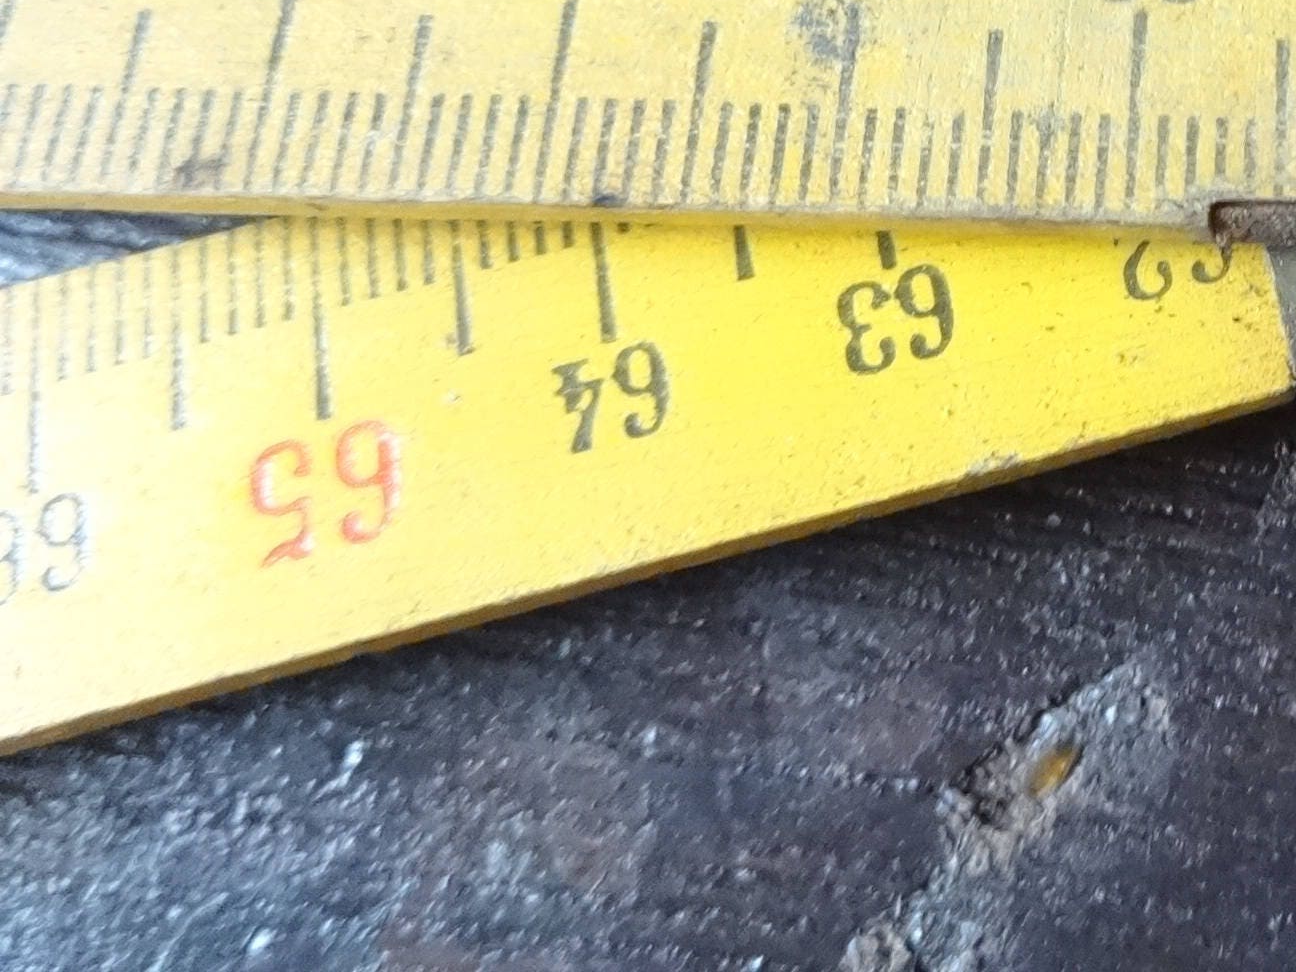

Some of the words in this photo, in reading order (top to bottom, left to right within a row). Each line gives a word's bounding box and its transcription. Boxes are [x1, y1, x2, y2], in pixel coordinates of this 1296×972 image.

[837, 264, 954, 375] 63
[551, 341, 670, 453] 64
[249, 419, 402, 568] 65
